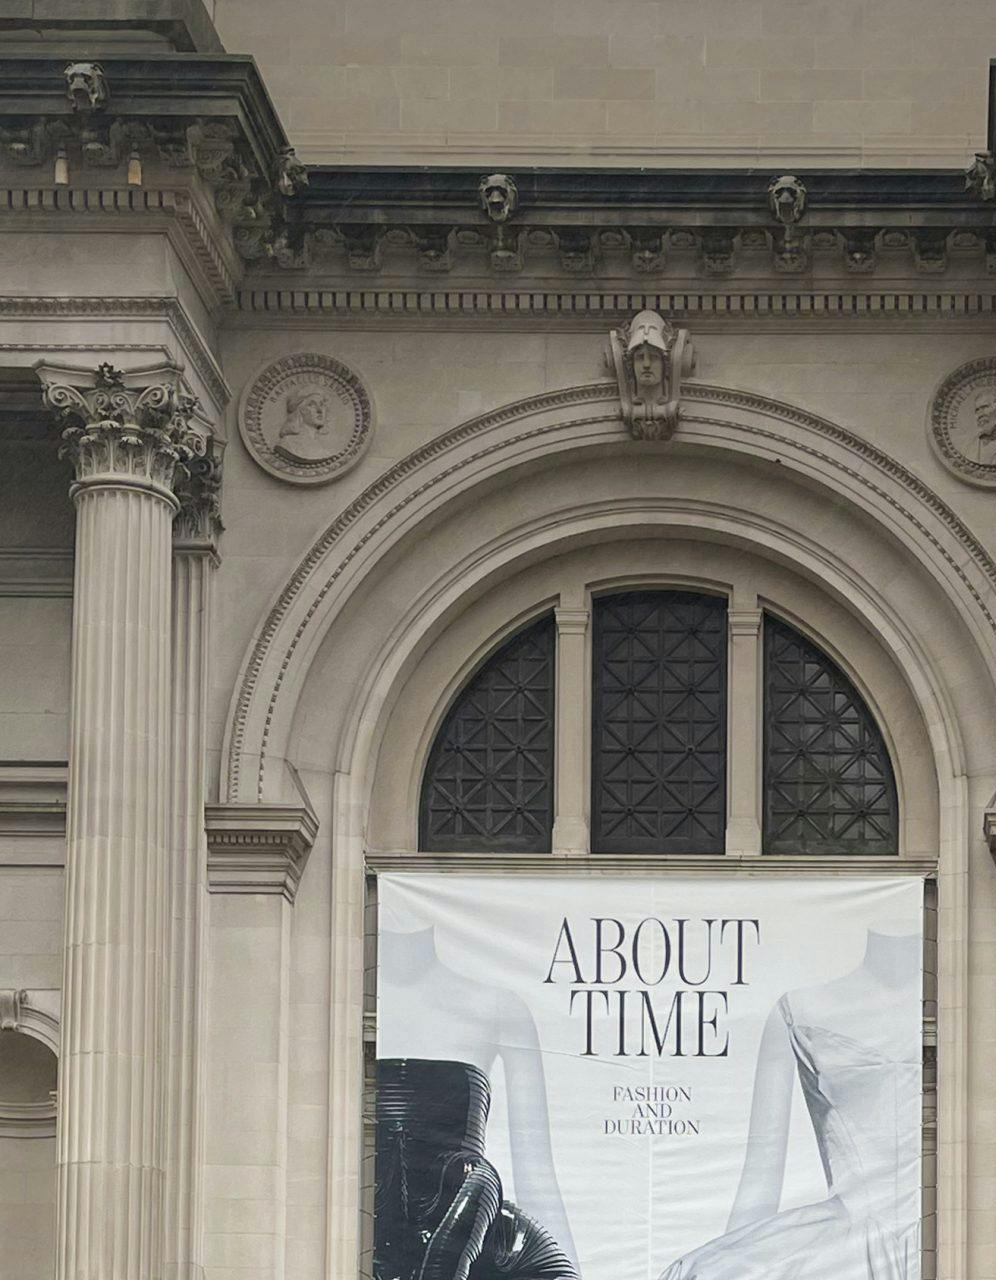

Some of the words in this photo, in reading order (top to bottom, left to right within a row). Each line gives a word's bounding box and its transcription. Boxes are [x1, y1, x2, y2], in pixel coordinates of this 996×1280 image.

[542, 917, 760, 986] ABOUT
[569, 989, 729, 1057] TIME
[613, 1086, 692, 1102] FASHION
[632, 1103, 672, 1118] AND
[603, 1119, 700, 1135] DURATION
